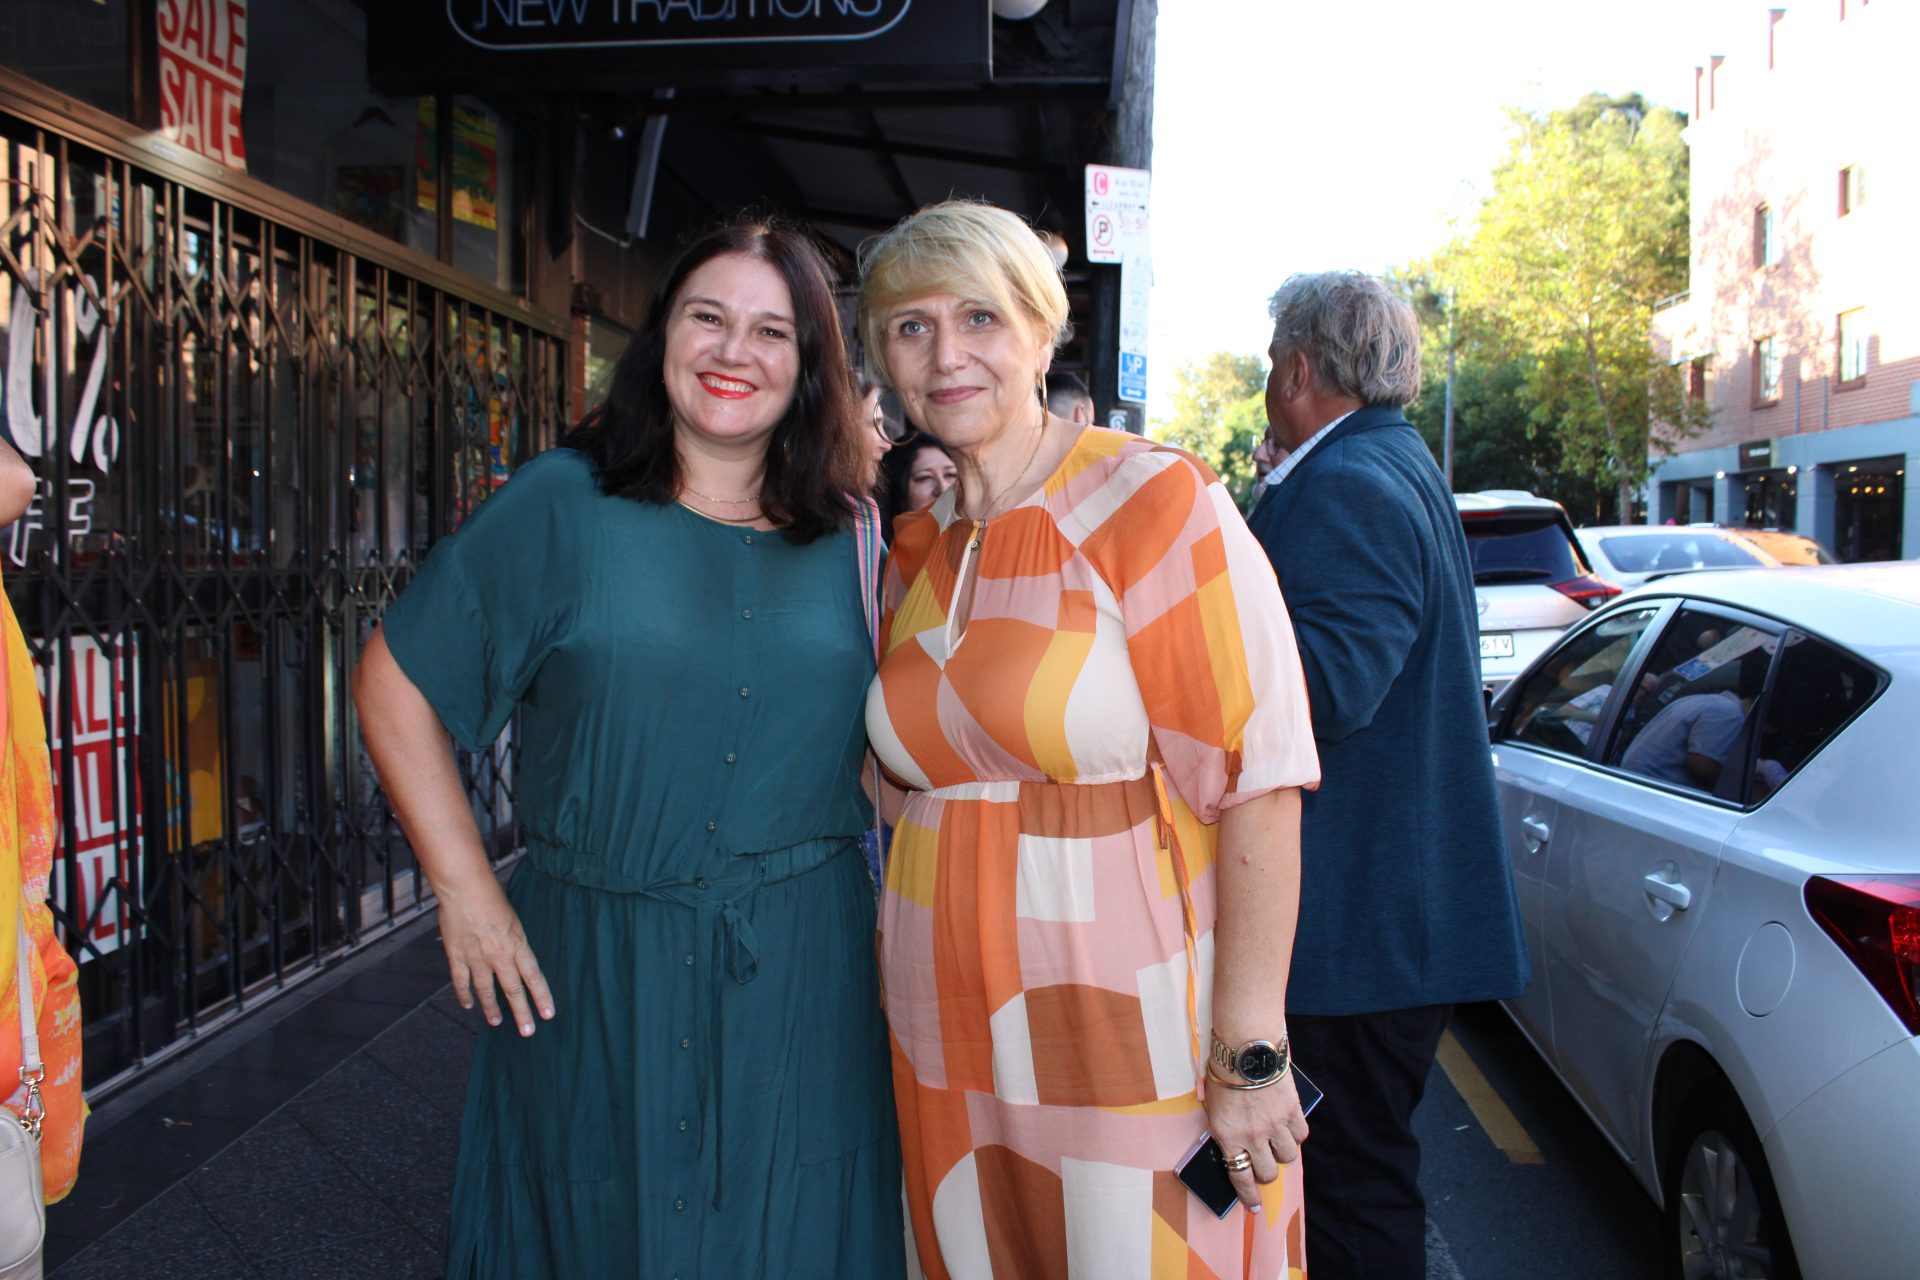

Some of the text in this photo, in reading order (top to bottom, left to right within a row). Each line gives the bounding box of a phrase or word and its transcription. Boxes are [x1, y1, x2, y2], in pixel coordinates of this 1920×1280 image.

[159, 0, 245, 81] SALE
[473, 0, 882, 30] NEW TRADITIONS
[161, 57, 247, 169] SALE
[0, 266, 120, 475] 0%
[1481, 638, 1510, 650] 61V
